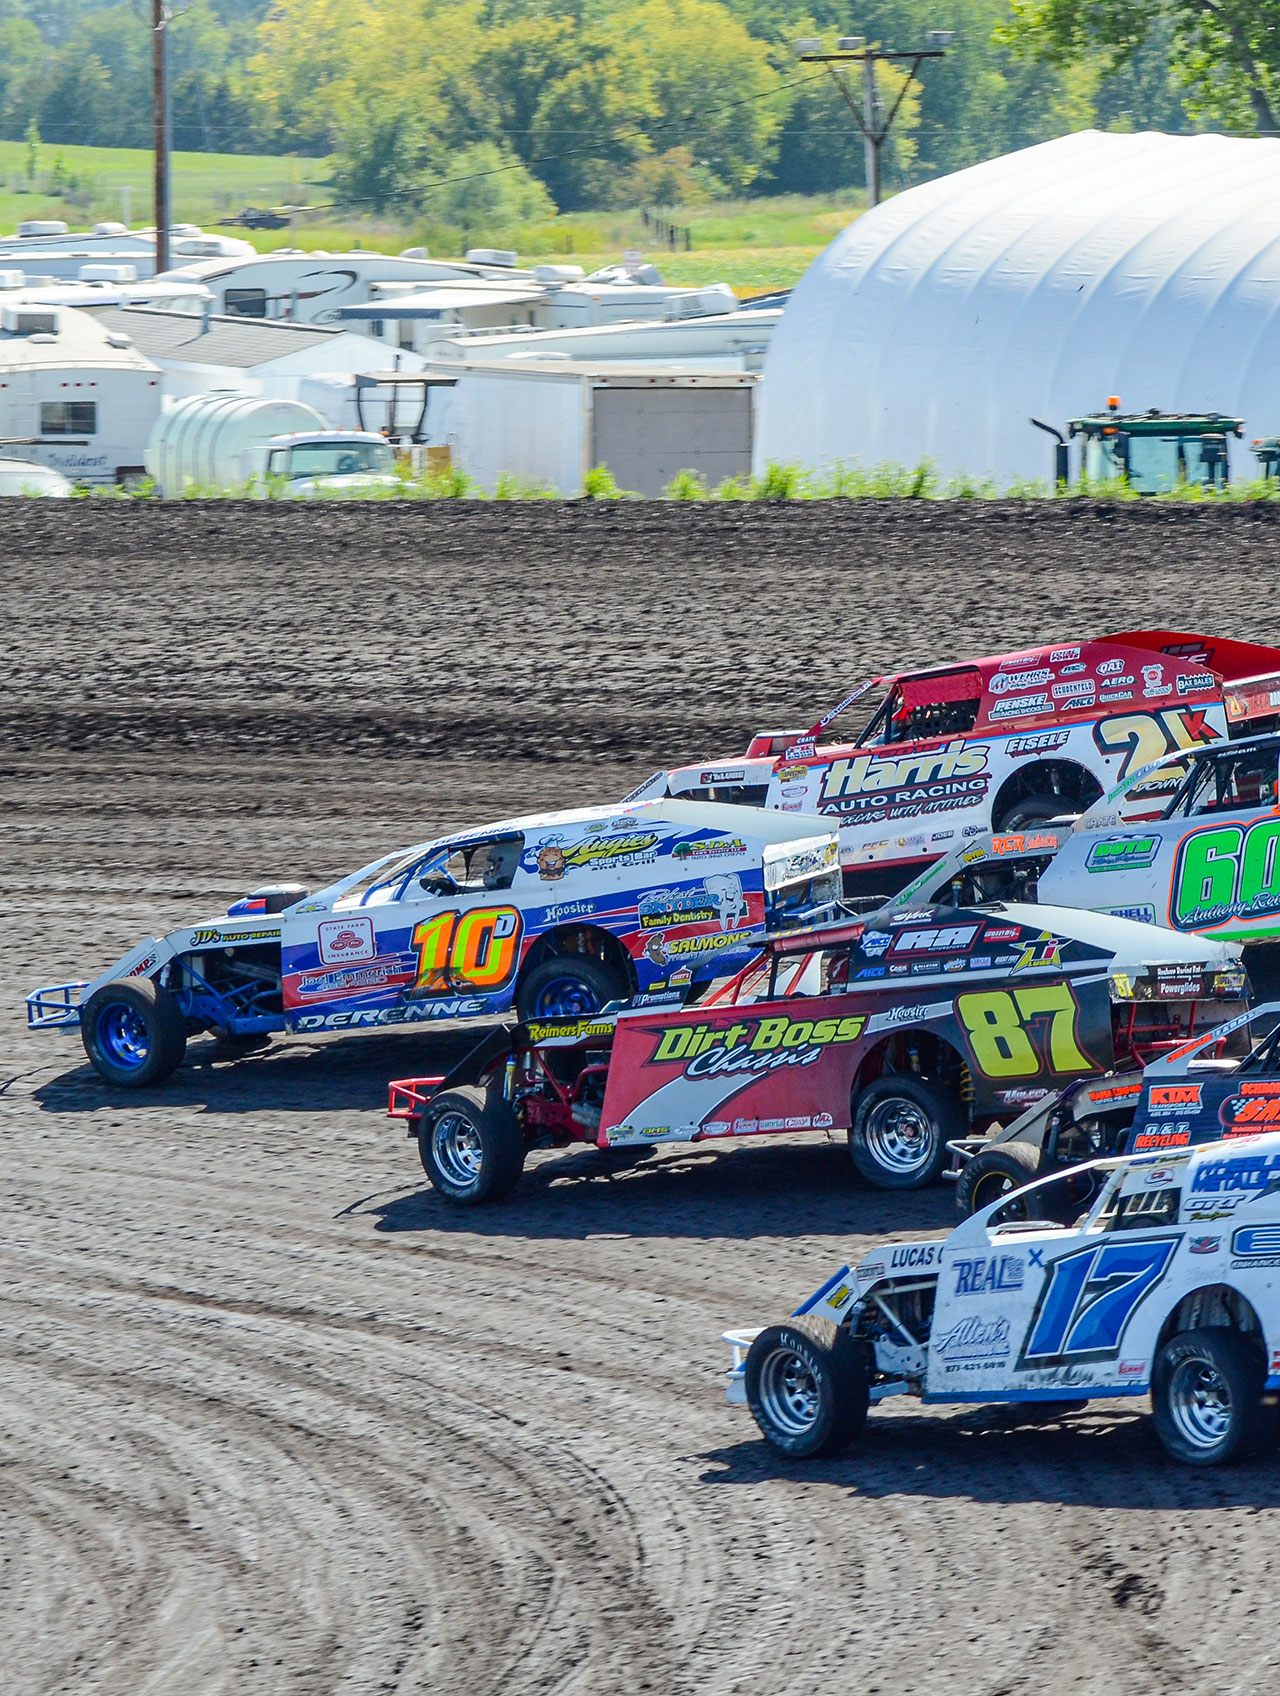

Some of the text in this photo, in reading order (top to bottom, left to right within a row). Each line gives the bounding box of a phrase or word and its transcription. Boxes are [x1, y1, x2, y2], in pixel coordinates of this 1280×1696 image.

[1101, 676, 1134, 687] AERO
[1179, 677, 1213, 690] BAX SALES
[996, 695, 1046, 712] PENSKE
[796, 736, 817, 745] CRATE
[1007, 731, 1069, 752] EISELE
[822, 739, 991, 798] Harris
[822, 779, 987, 815] AUTO RACING
[888, 793, 984, 818] WITH ATTITUDE
[1083, 815, 1117, 830] CRATE
[562, 832, 659, 862] Augies
[1093, 839, 1156, 858] ROTH
[589, 850, 657, 867] Sports Bar
[591, 858, 656, 872] and Grill
[543, 901, 597, 923] Hoosier
[639, 893, 721, 916] SNYDER
[1181, 902, 1247, 924] Anthony
[325, 921, 366, 931] STATE FARM
[642, 910, 713, 927] Family Dentistry
[190, 929, 222, 946] JD's
[222, 933, 249, 942] AUTO
[328, 950, 369, 959] INSURANCE
[301, 971, 330, 986] Joel
[334, 965, 403, 983] Emmerich
[1160, 982, 1201, 995] Powerglides
[298, 997, 489, 1029] DERENNE
[886, 1004, 930, 1021] Hoosier
[653, 1016, 867, 1062] Dirt Boss
[957, 980, 1094, 1078] 87
[685, 1043, 822, 1076] Chassis
[1150, 1085, 1201, 1105] KTM
[1231, 1125, 1262, 1133] RACING
[1135, 1132, 1191, 1149] RECYCLING
[1191, 1170, 1270, 1193] METALS
[890, 1246, 935, 1268] LUCAS
[950, 1256, 1023, 1296] REAL
[1018, 1235, 1184, 1368] 17
